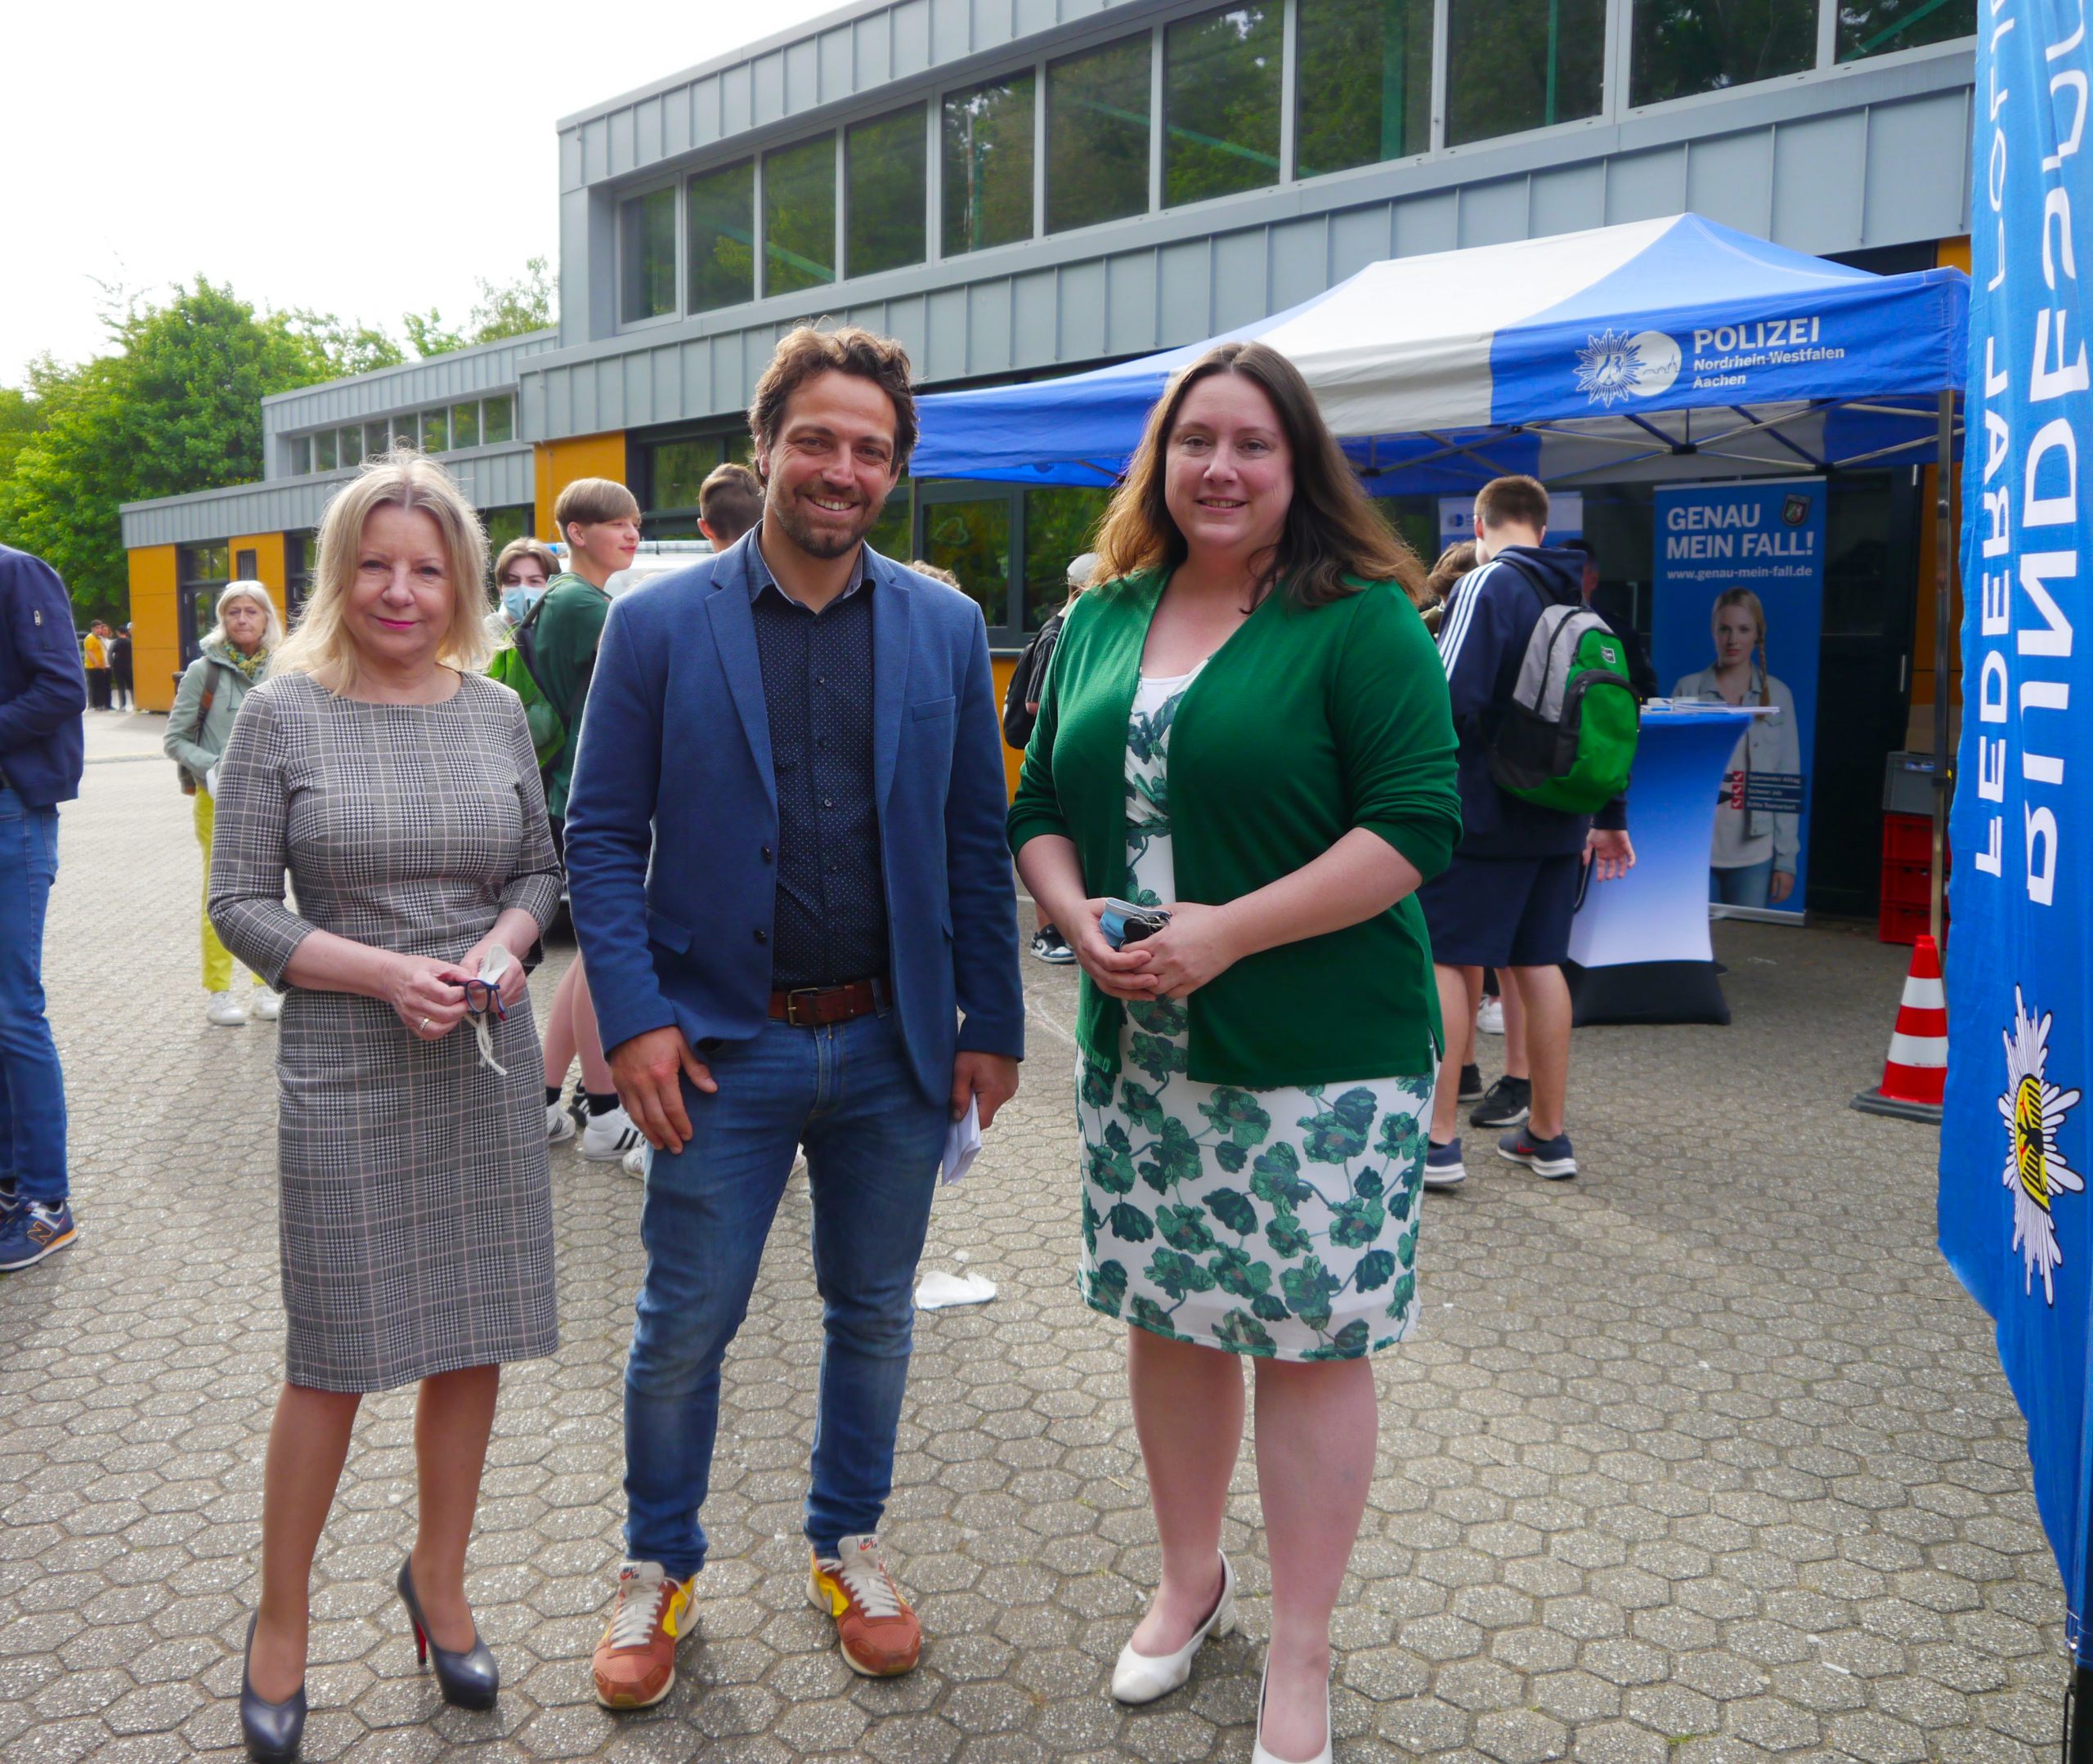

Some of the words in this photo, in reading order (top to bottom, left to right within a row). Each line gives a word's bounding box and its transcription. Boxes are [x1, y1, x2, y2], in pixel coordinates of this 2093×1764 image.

[1694, 316, 1819, 353] POLIZEI
[1694, 347, 1844, 370] Nordrhein-Westfalen
[1692, 373, 1746, 389] Aachen
[1667, 503, 1760, 531] GENAU
[1667, 535, 1732, 559] MEIN
[1741, 531, 1813, 556] FALL!
[1667, 566, 1813, 580] www.genau-mein-fall.de
